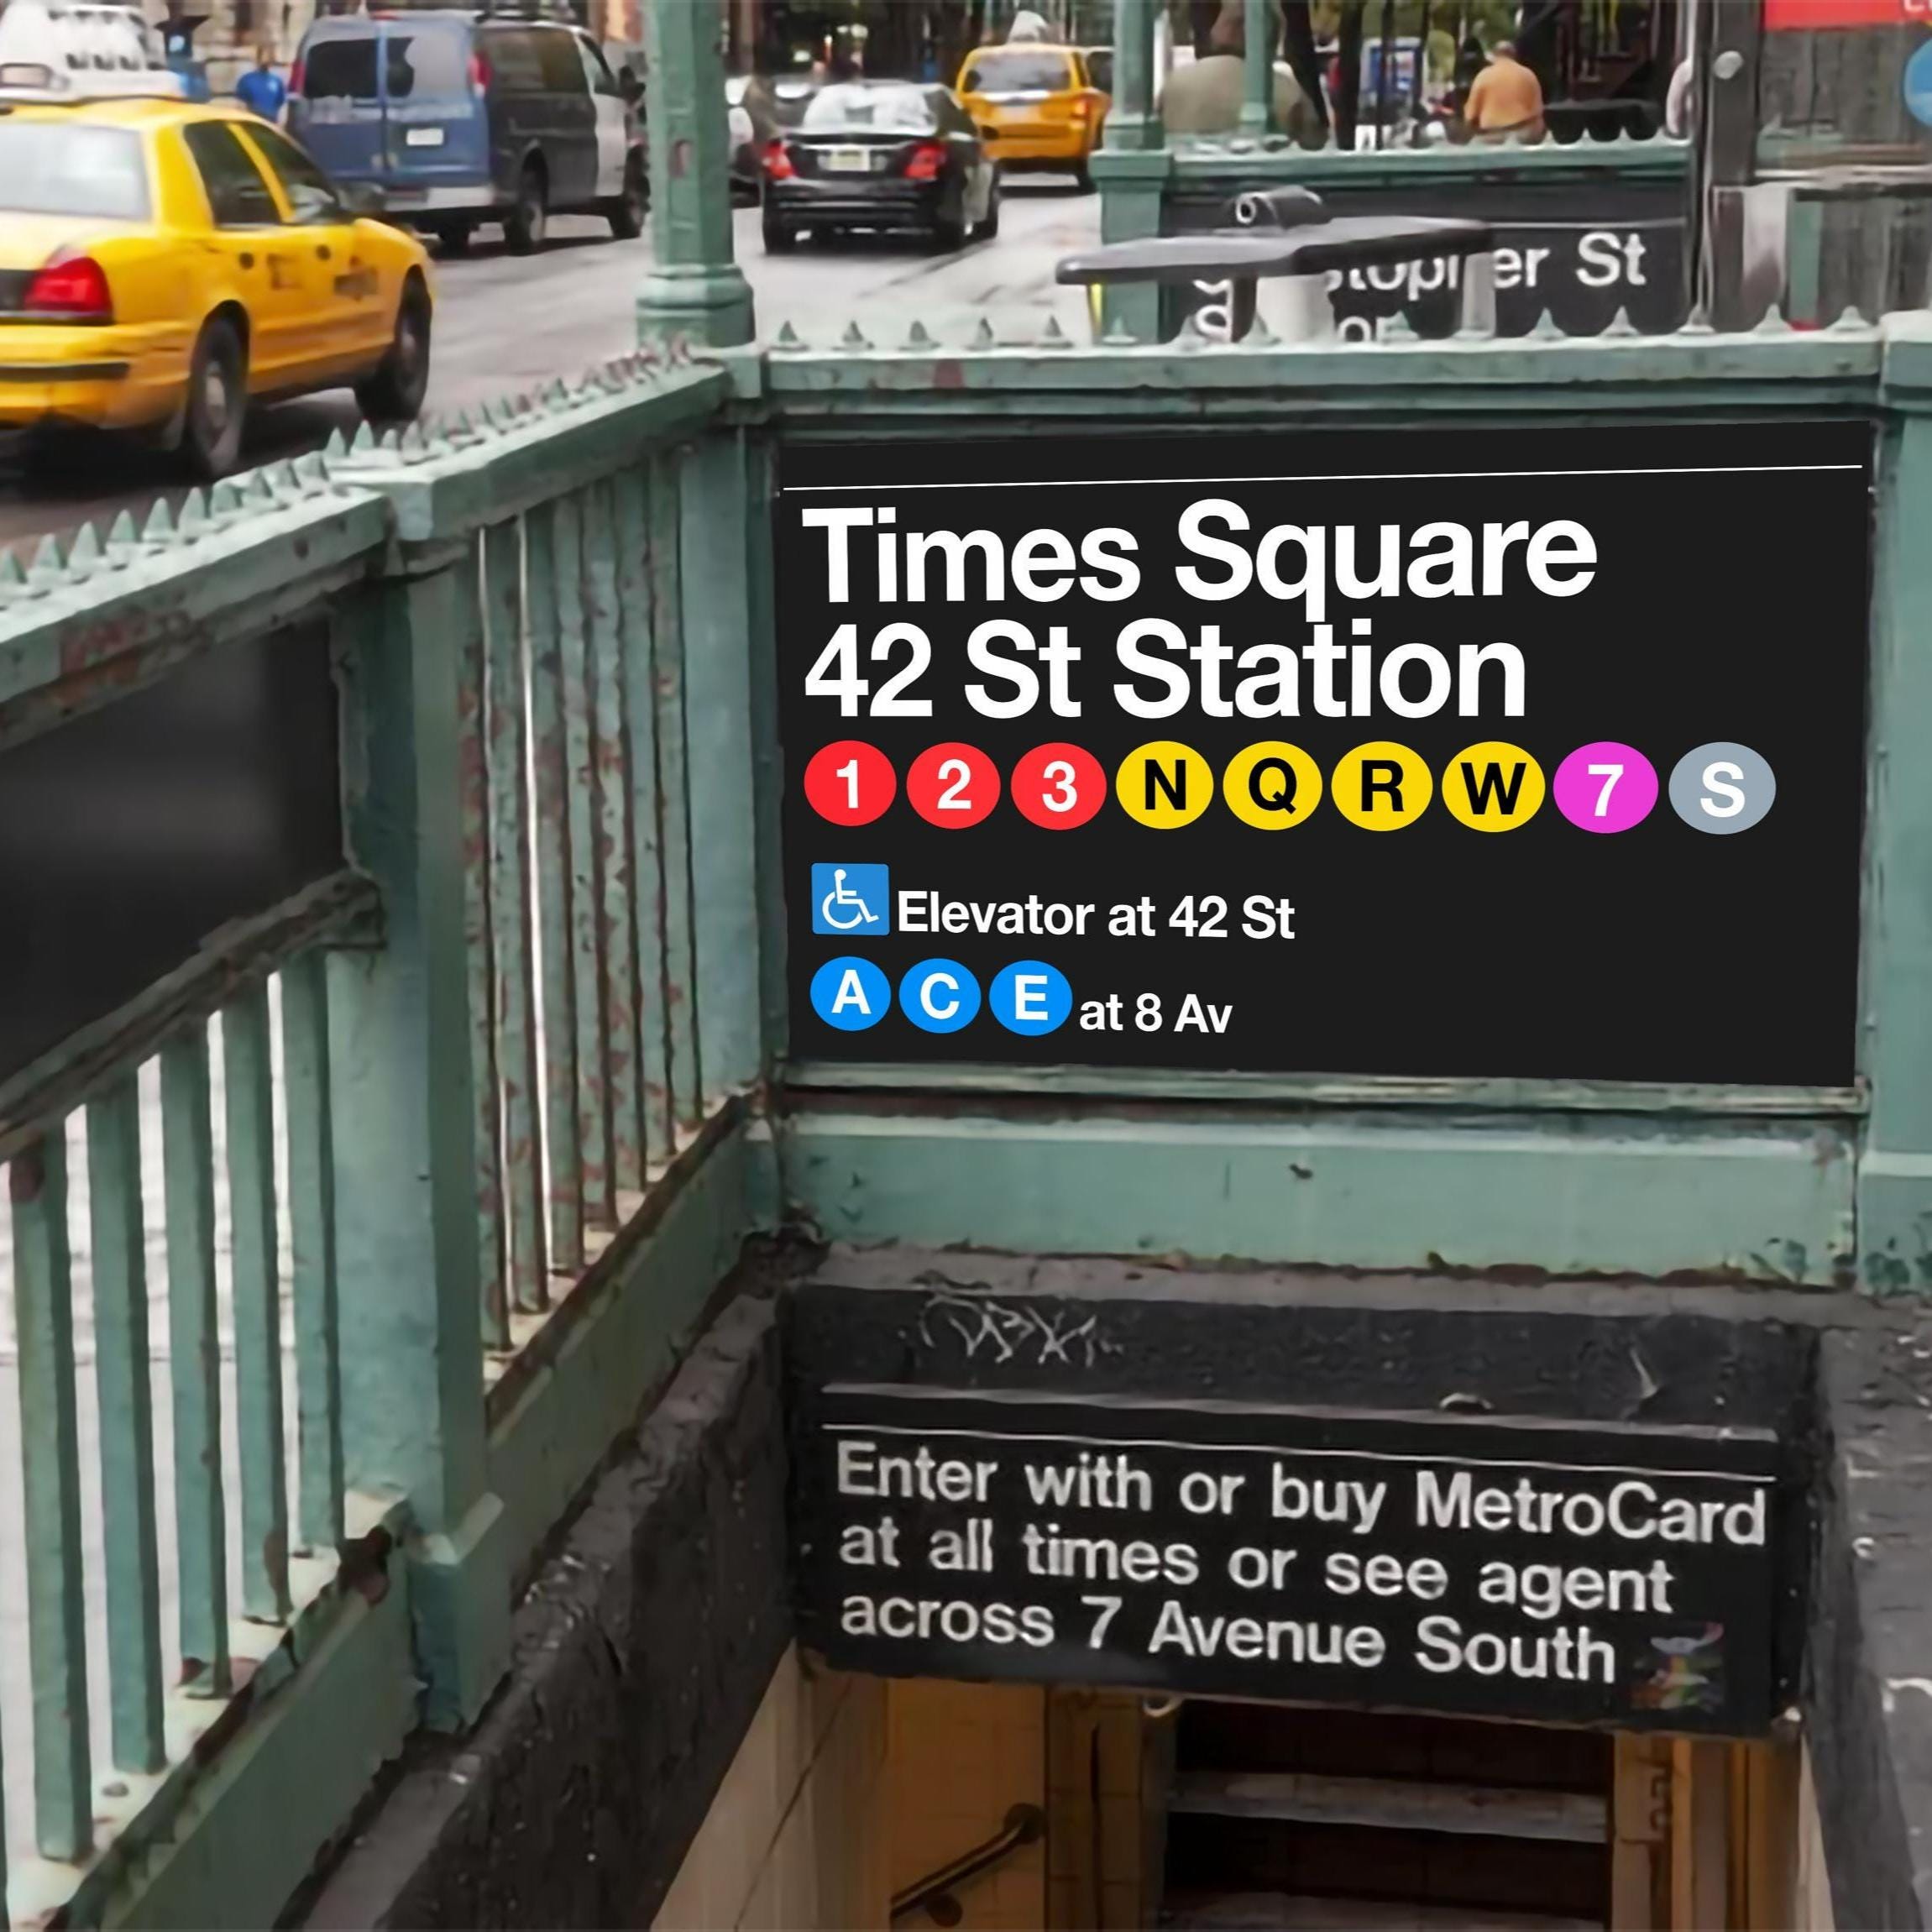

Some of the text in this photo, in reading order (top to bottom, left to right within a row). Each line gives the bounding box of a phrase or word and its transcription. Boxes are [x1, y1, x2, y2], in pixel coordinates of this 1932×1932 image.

[1575, 231, 1647, 288] St
[801, 497, 1598, 623] Times Square
[804, 617, 1526, 720] 42 St Station
[836, 757, 1746, 818] 1 2 3 N Q R W 7 S
[898, 890, 1296, 940] Elevator at 42 St
[831, 969, 1233, 1034] A C E at 8 Av
[838, 1440, 1767, 1546] Enter with or buy MetroCard
[840, 1516, 1675, 1620] at all times or see agent
[841, 1595, 1615, 1684] across 7 Avenue South
